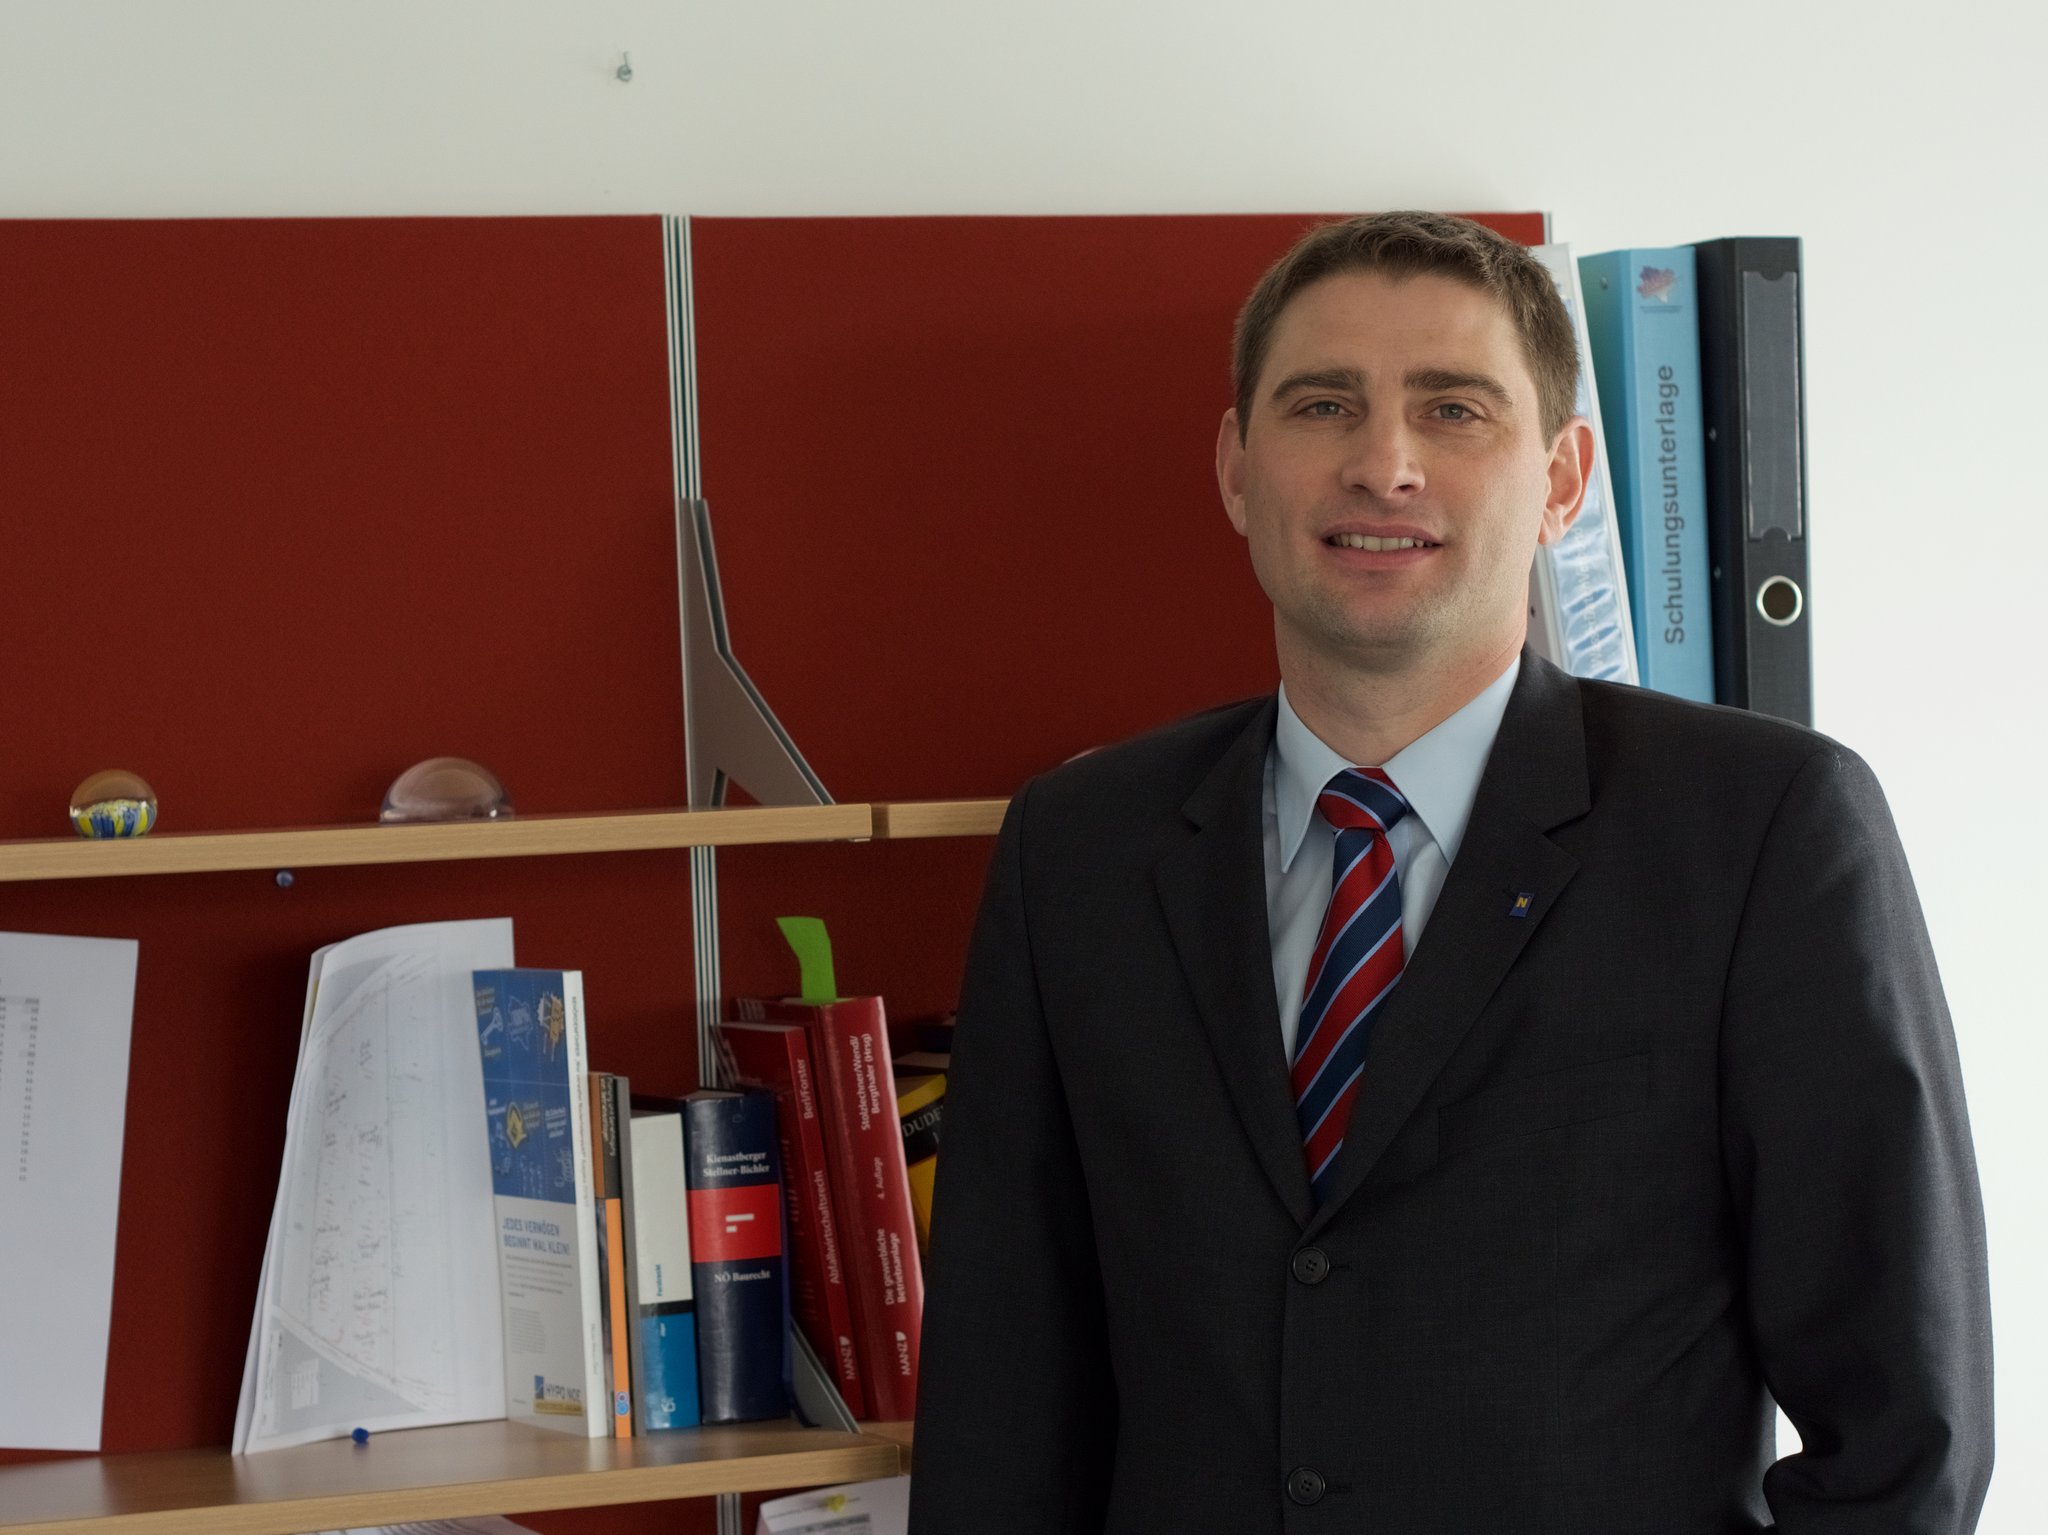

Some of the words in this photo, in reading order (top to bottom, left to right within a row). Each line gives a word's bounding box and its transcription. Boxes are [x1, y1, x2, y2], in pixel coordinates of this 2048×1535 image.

[1656, 364, 1685, 645] Schulungsunterlage
[796, 1058, 814, 1120] Berl/Forster
[849, 1035, 871, 1131] Stolzlechner/Wendl/
[866, 1064, 881, 1115] Bergthaler
[902, 1105, 944, 1136] DUDE
[703, 1164, 770, 1178] Stellner-Bichler
[706, 1152, 767, 1164] Kienastberger
[873, 1156, 885, 1189] Auflage
[812, 1169, 841, 1285] Abfallwirtschaftsrecht
[876, 1227, 893, 1287] gewerbliche
[889, 1232, 907, 1304] Betriebsanlage
[714, 1271, 731, 1283] NÖ
[733, 1270, 771, 1281] Baurecht
[884, 1288, 895, 1306] Die
[842, 1346, 856, 1380] MANZ
[896, 1341, 912, 1376] MANZ
